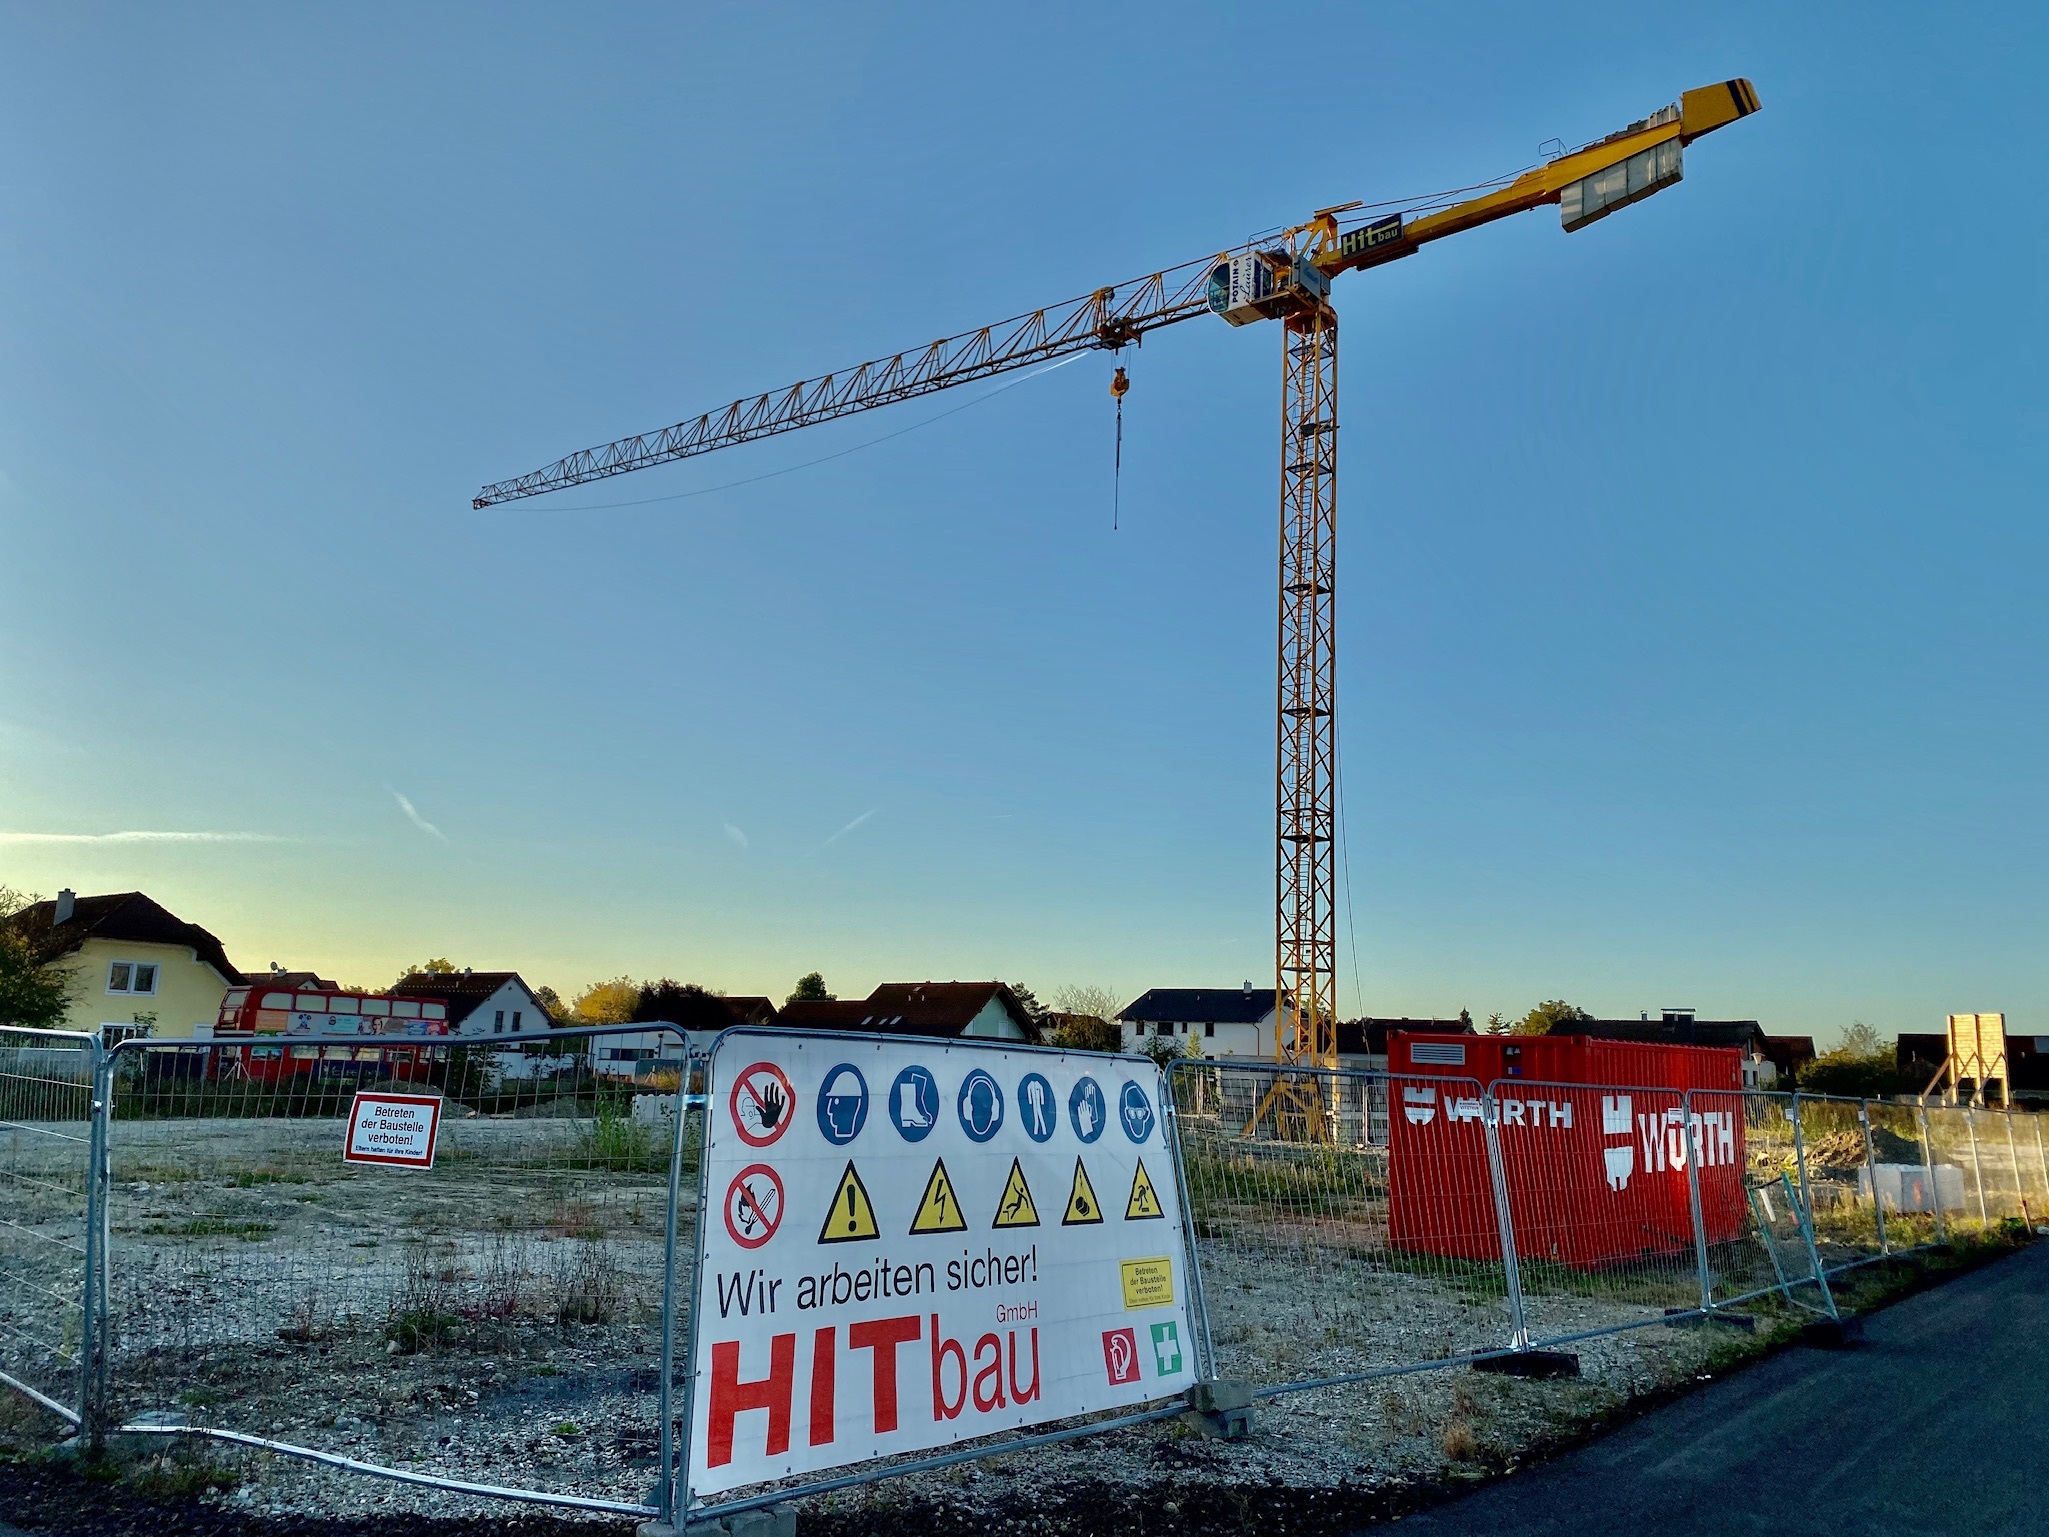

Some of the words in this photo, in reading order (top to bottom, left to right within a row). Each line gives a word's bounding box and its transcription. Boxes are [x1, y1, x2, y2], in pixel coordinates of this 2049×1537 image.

[374, 1106, 415, 1119] Betreten
[361, 1118, 378, 1129] der
[380, 1119, 424, 1133] Baustelle
[368, 1132, 414, 1145] verboten!
[1135, 1267, 1158, 1276] Betreten
[717, 1269, 783, 1319] Wir
[797, 1256, 935, 1310] arbeiten
[947, 1244, 1038, 1292] sicher!
[1130, 1278, 1139, 1286] der
[1140, 1275, 1166, 1285] Baustelle
[996, 1300, 1039, 1323] GmbH
